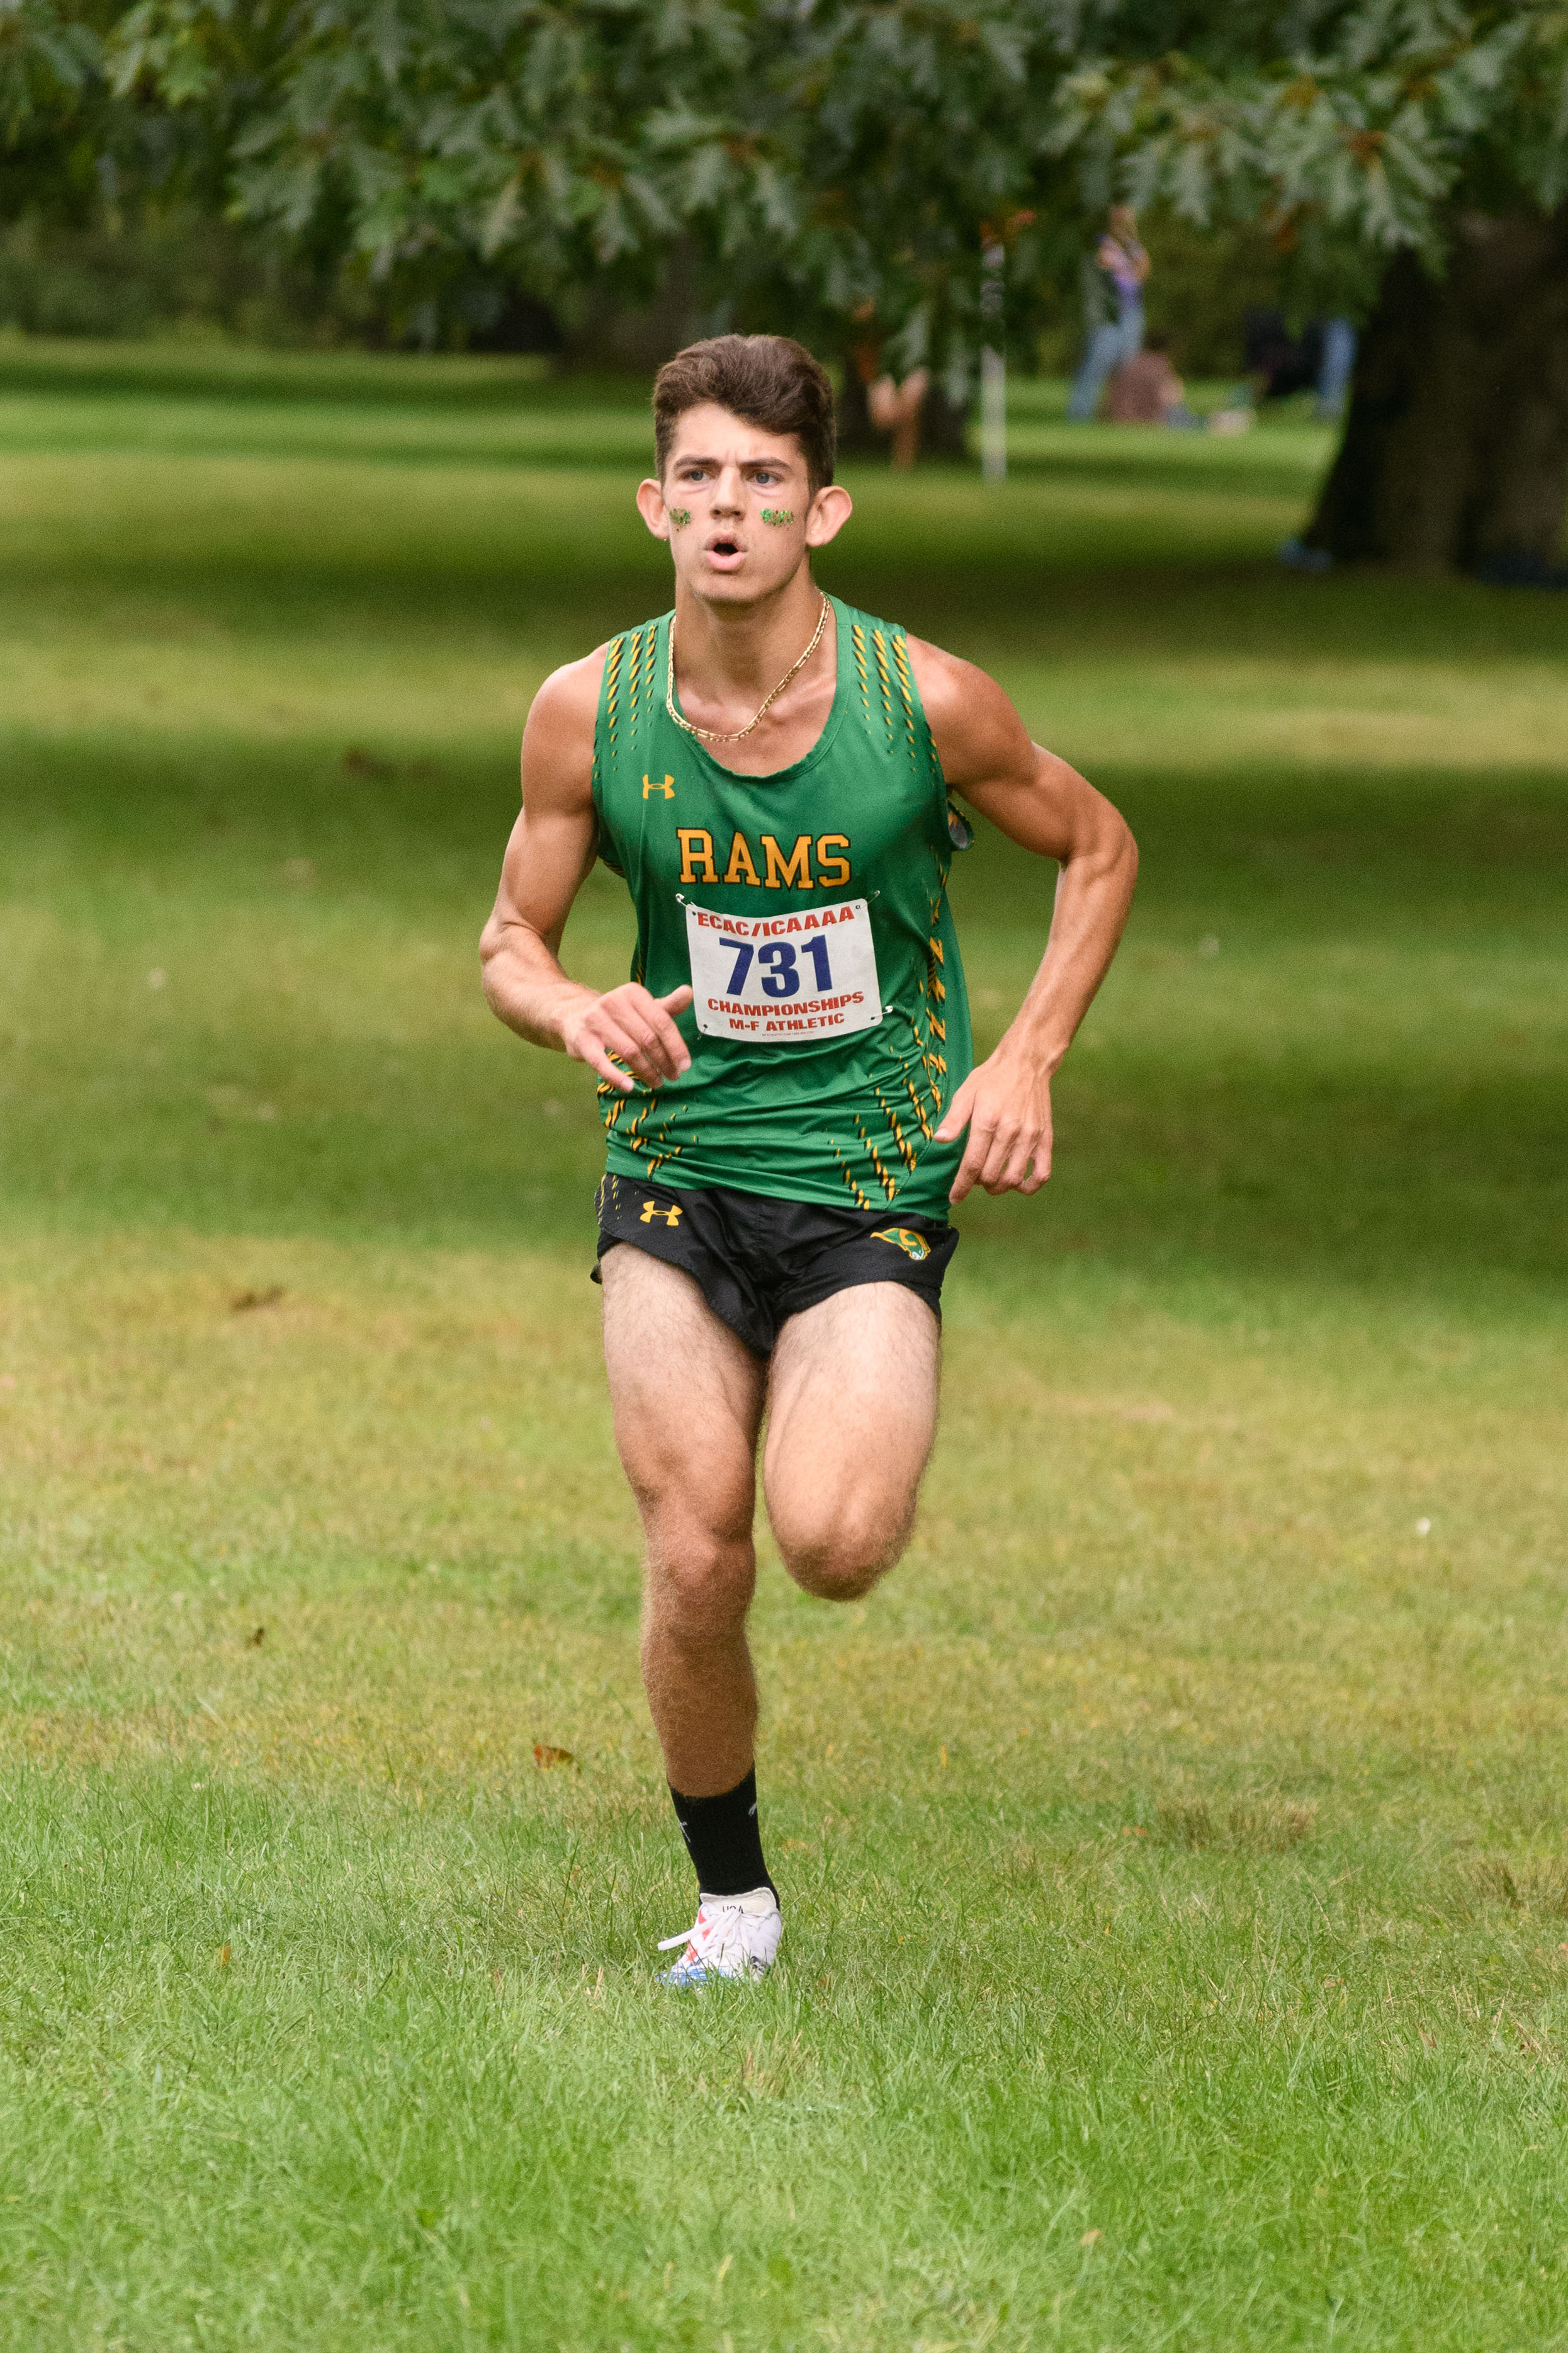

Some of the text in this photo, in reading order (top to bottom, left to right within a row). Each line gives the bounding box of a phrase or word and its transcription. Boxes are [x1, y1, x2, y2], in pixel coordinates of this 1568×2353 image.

[676, 827, 851, 891] RAMS
[697, 906, 855, 937] ECAC/ICAAAA
[719, 934, 833, 998] 731
[708, 991, 864, 1016] CHAMPIONSHIPS
[729, 1013, 845, 1031] M-F ATHLETIC
